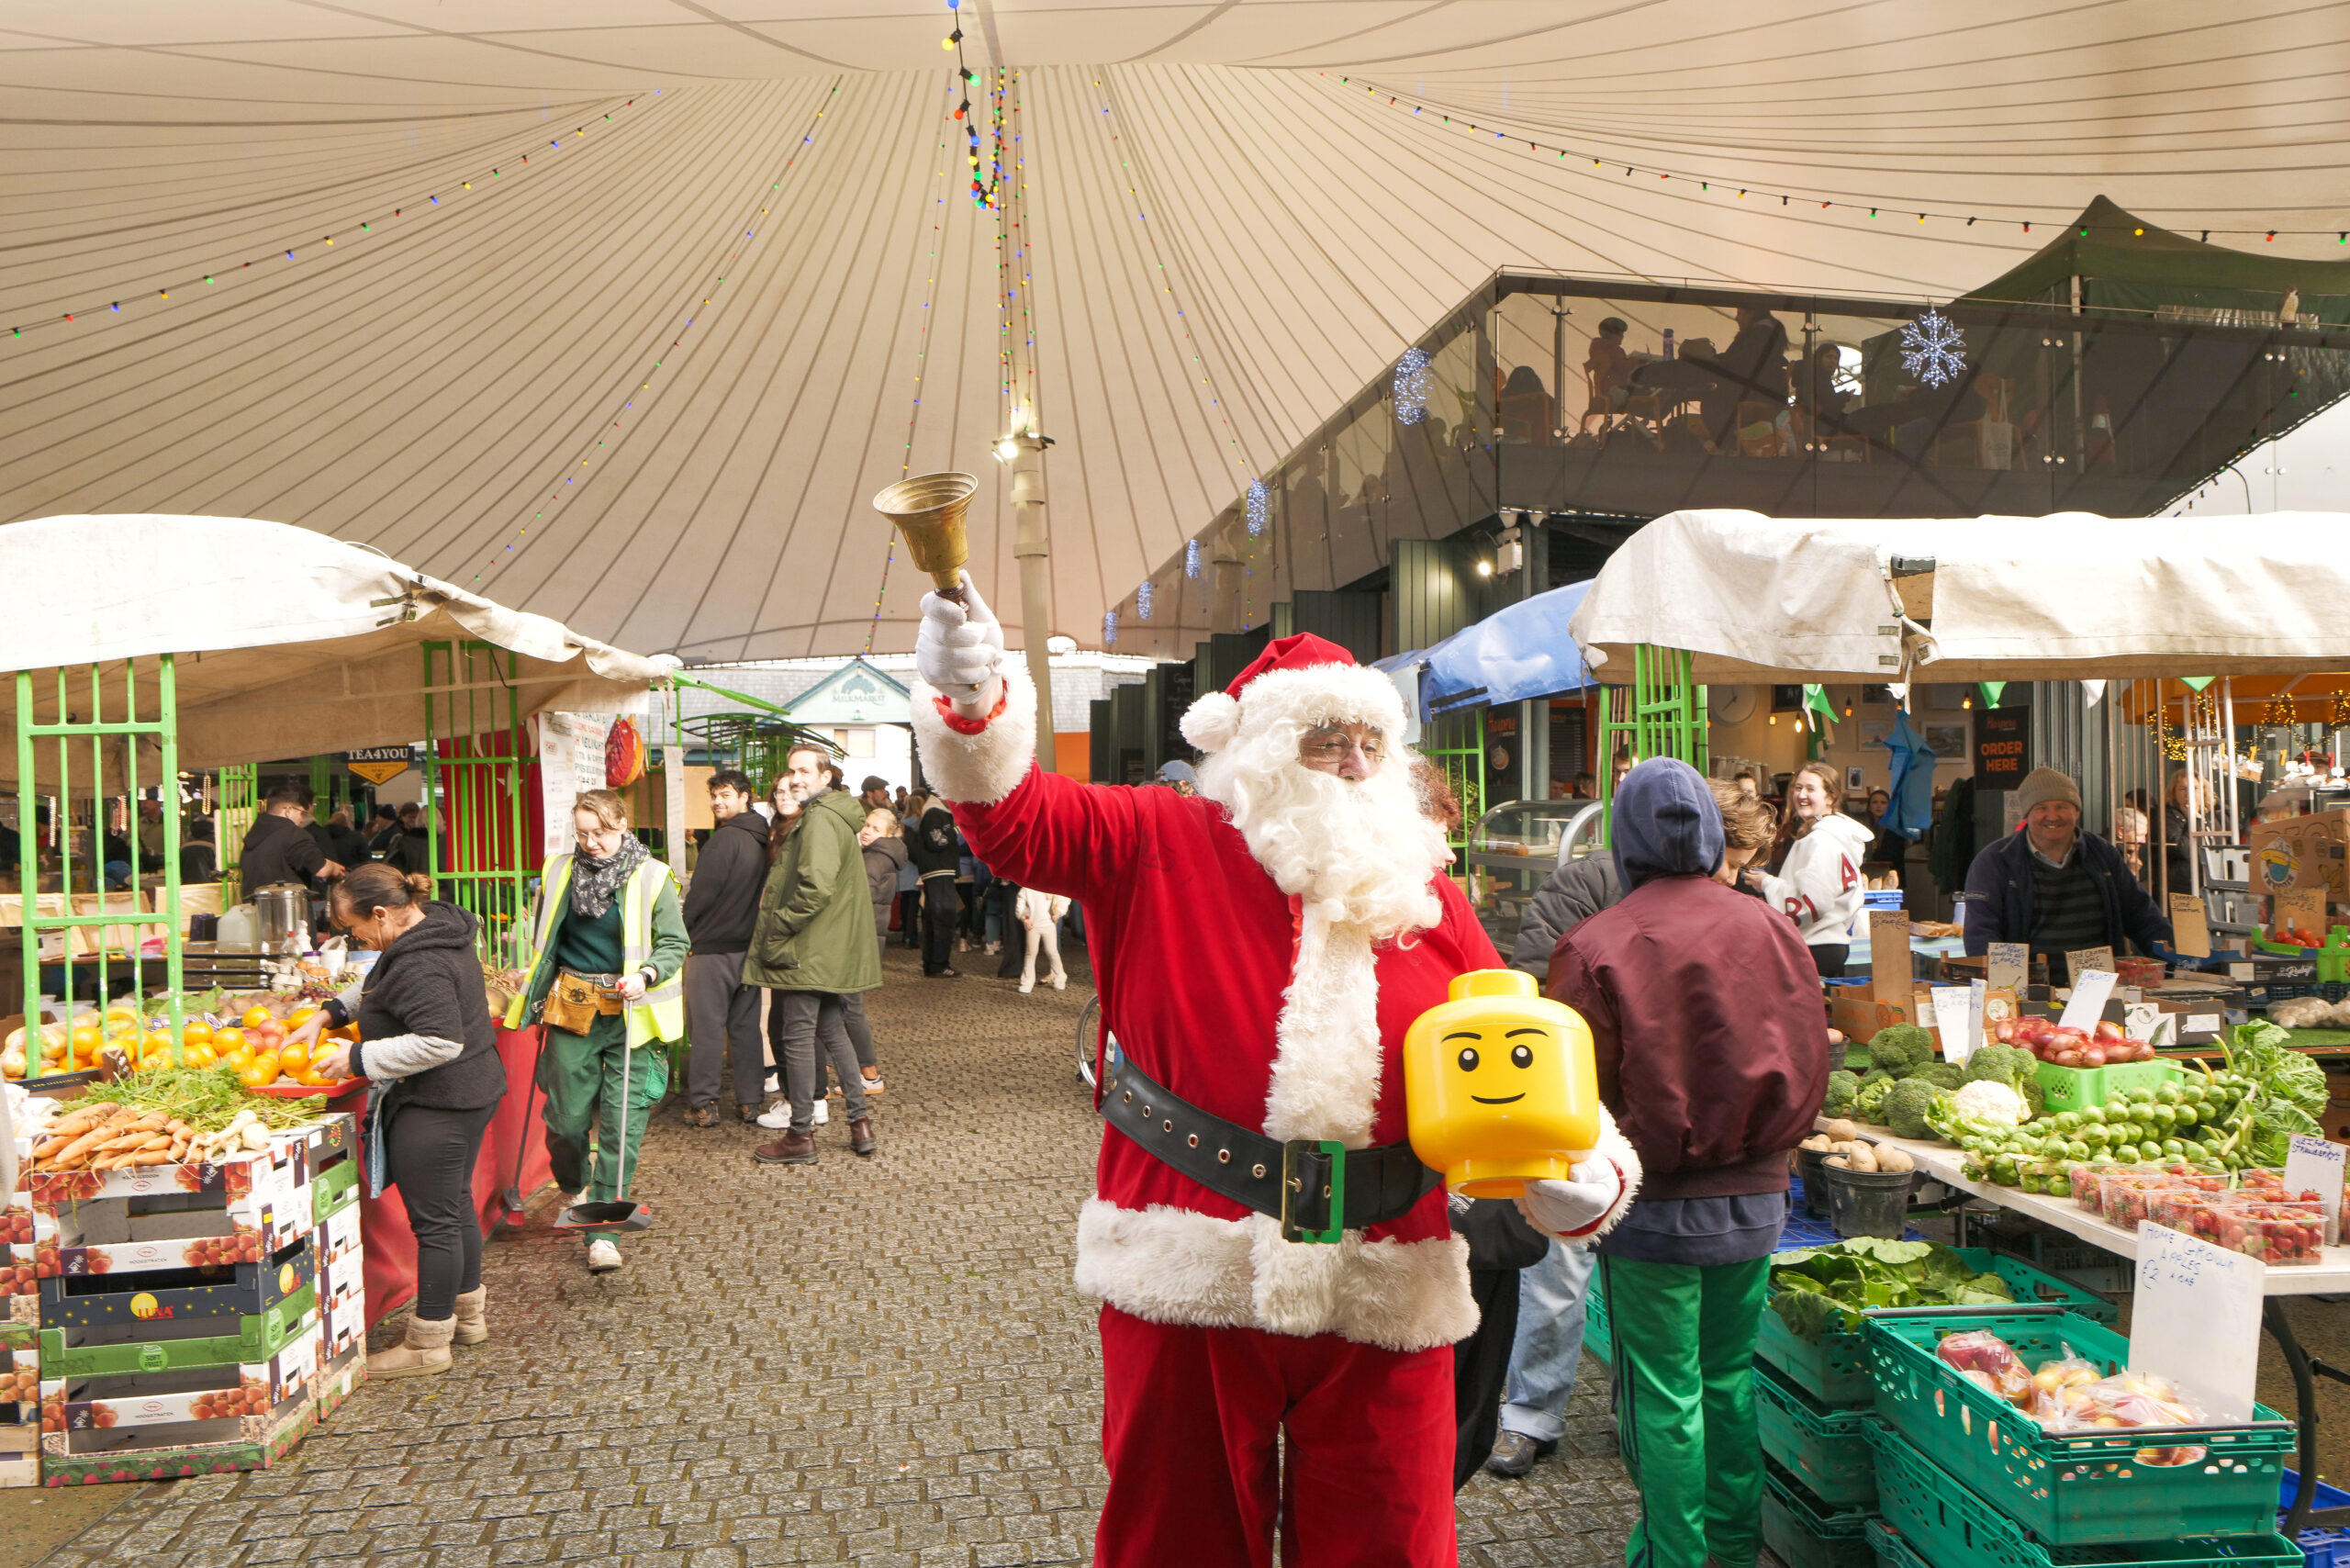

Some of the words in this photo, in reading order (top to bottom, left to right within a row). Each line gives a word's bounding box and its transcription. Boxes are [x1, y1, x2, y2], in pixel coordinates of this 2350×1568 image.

[347, 747, 409, 760] TEA4YOU
[1980, 741, 2024, 756] ORDER
[1986, 757, 2019, 772] HERE
[2144, 1226, 2176, 1244] HOME
[2183, 1238, 2234, 1271] GROWN
[2160, 1249, 2201, 1275] APPLES
[138, 1305, 174, 1320] LUNA
